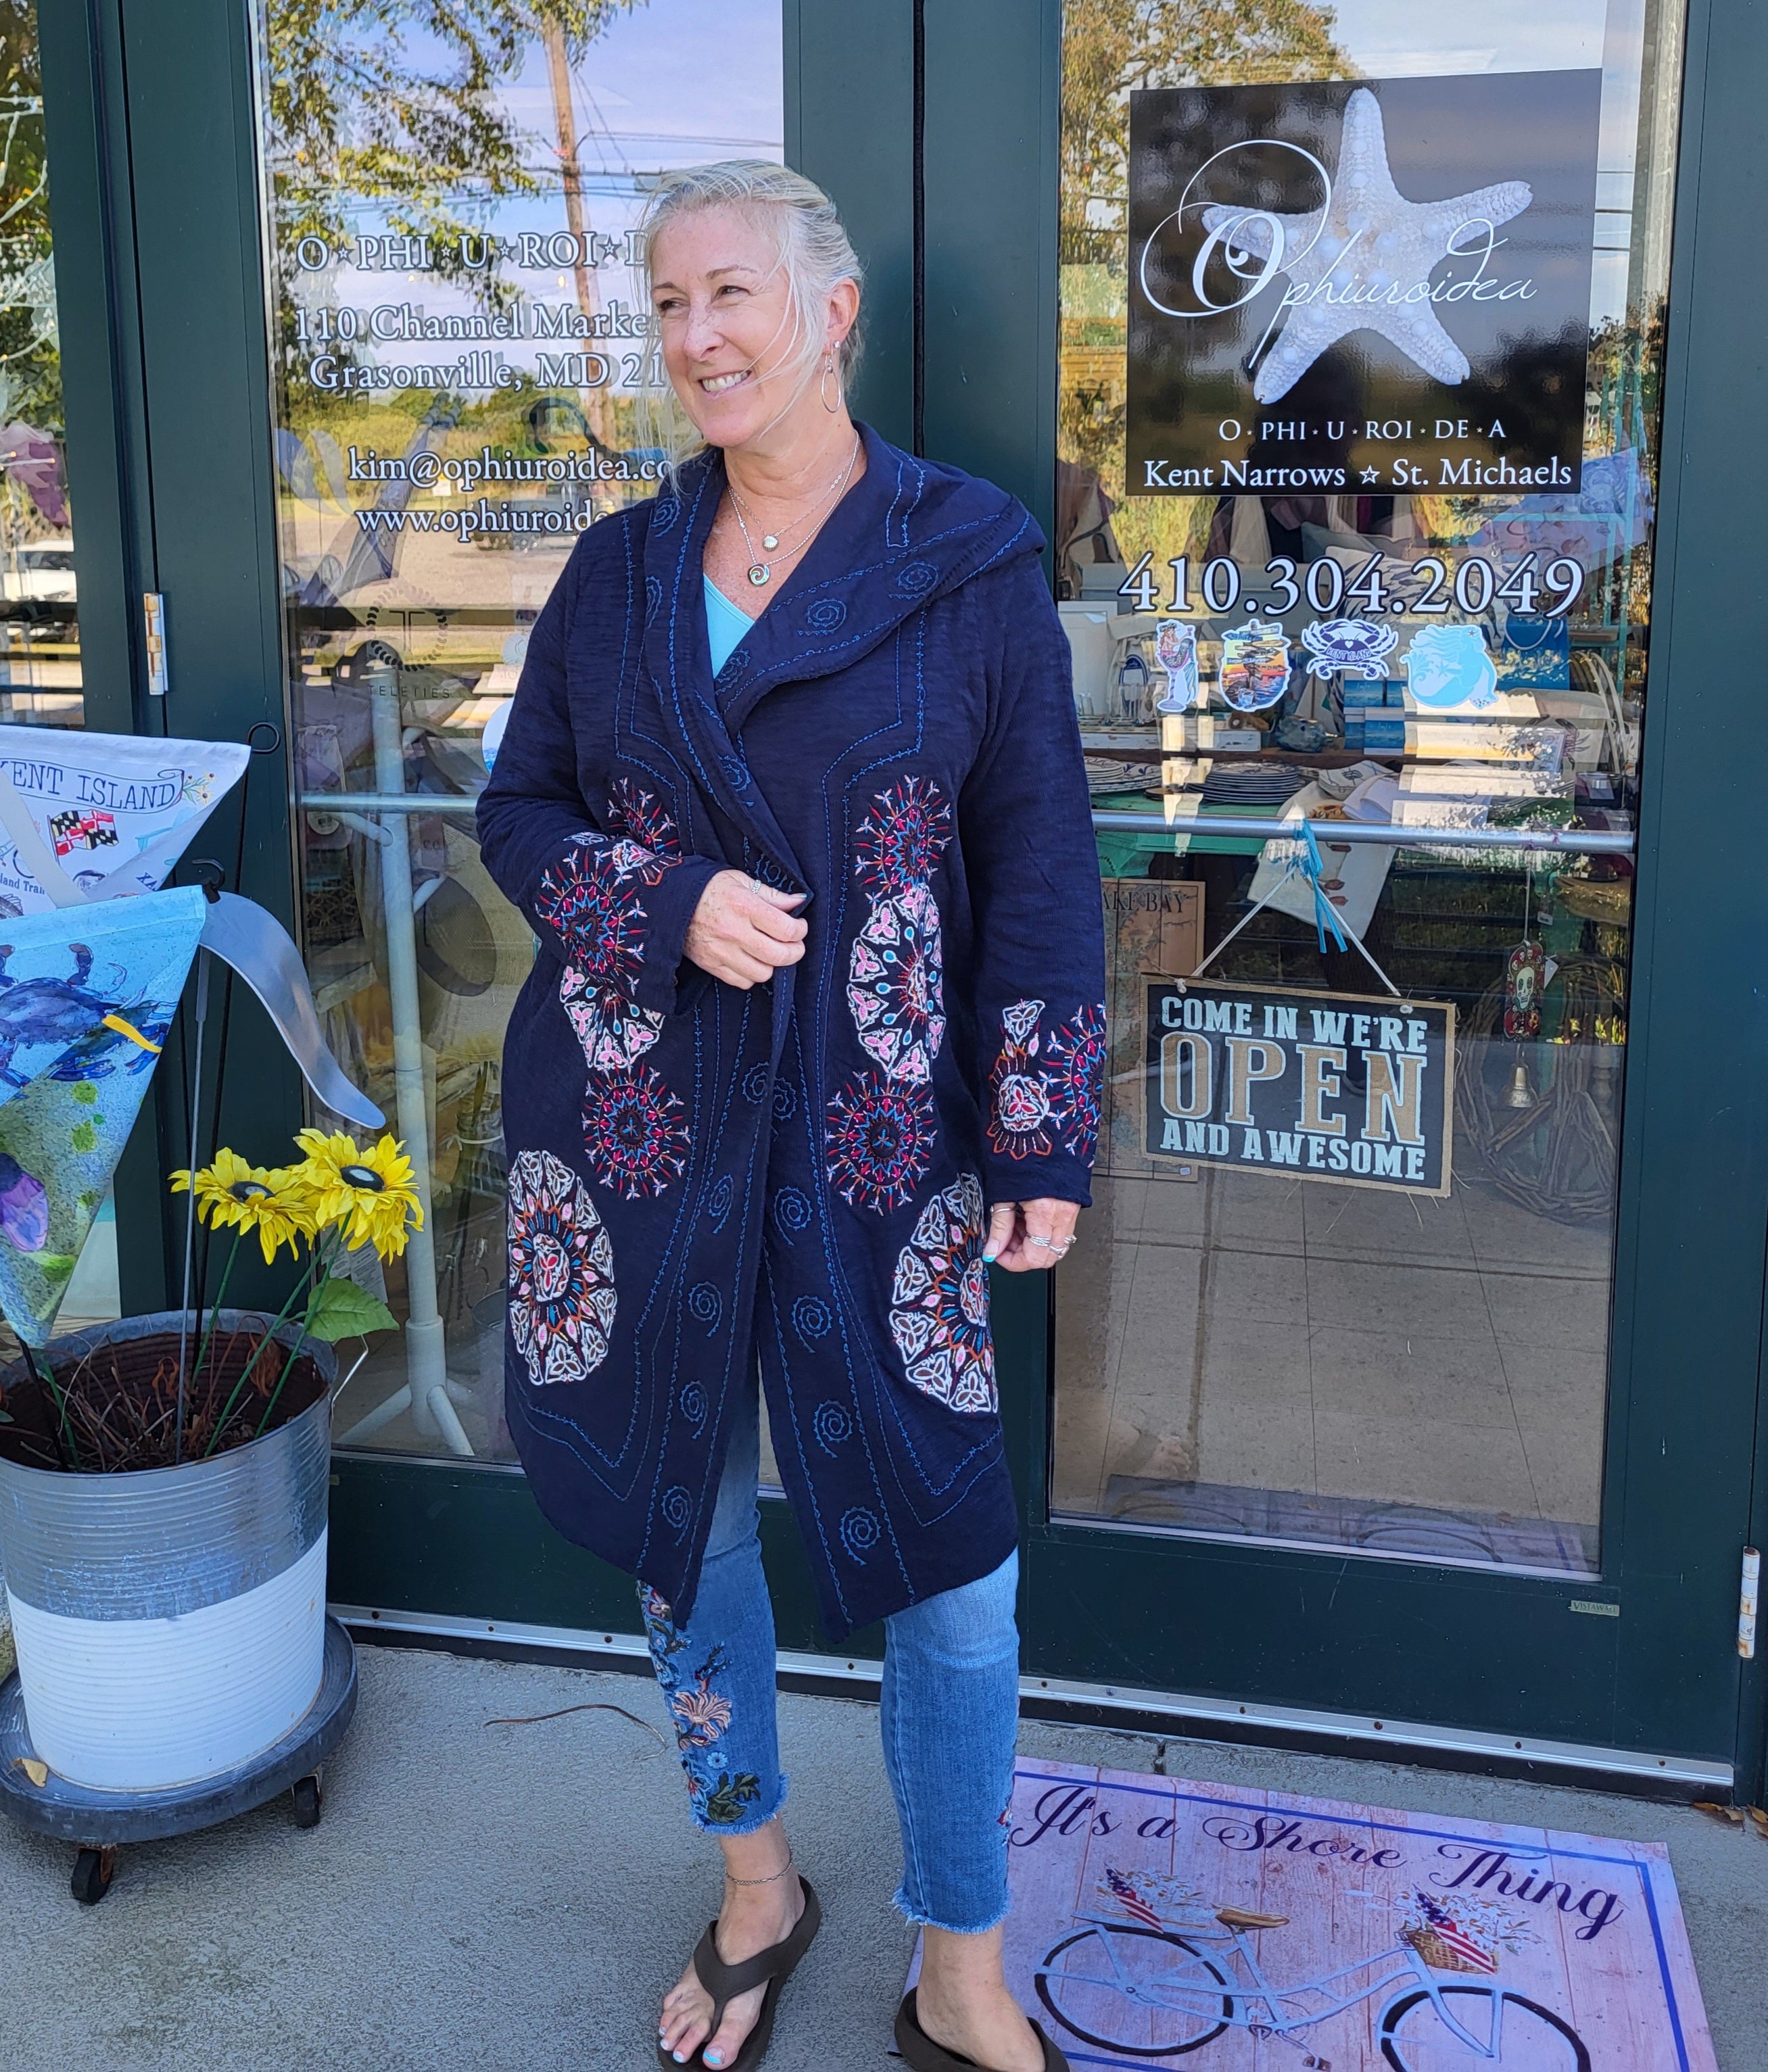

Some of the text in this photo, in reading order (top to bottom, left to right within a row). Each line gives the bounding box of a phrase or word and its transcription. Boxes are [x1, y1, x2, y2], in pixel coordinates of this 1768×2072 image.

[296, 237, 329, 270] O
[356, 235, 431, 270] PHI
[459, 232, 491, 268] U
[519, 231, 598, 267] ROI
[1141, 139, 1538, 369] Ophiuroidea
[296, 307, 358, 341] 110
[371, 302, 523, 340] Channel
[309, 351, 524, 392] Grasonville,
[537, 352, 609, 389] MD
[1219, 419, 1507, 442] O PHI U ROI DE A
[1143, 456, 1572, 487] Kent Narrows St. Michaels
[1117, 551, 1585, 619] 410.304.2049
[76, 774, 176, 810] ISLAND
[1145, 892, 1187, 913] BAY
[1162, 996, 1428, 1053] COME IN WE'RE
[1160, 1030, 1428, 1147] OPEN
[1160, 1117, 1426, 1181] AND AWESOME
[1011, 1785, 1624, 1941] It's a Shore Thing
